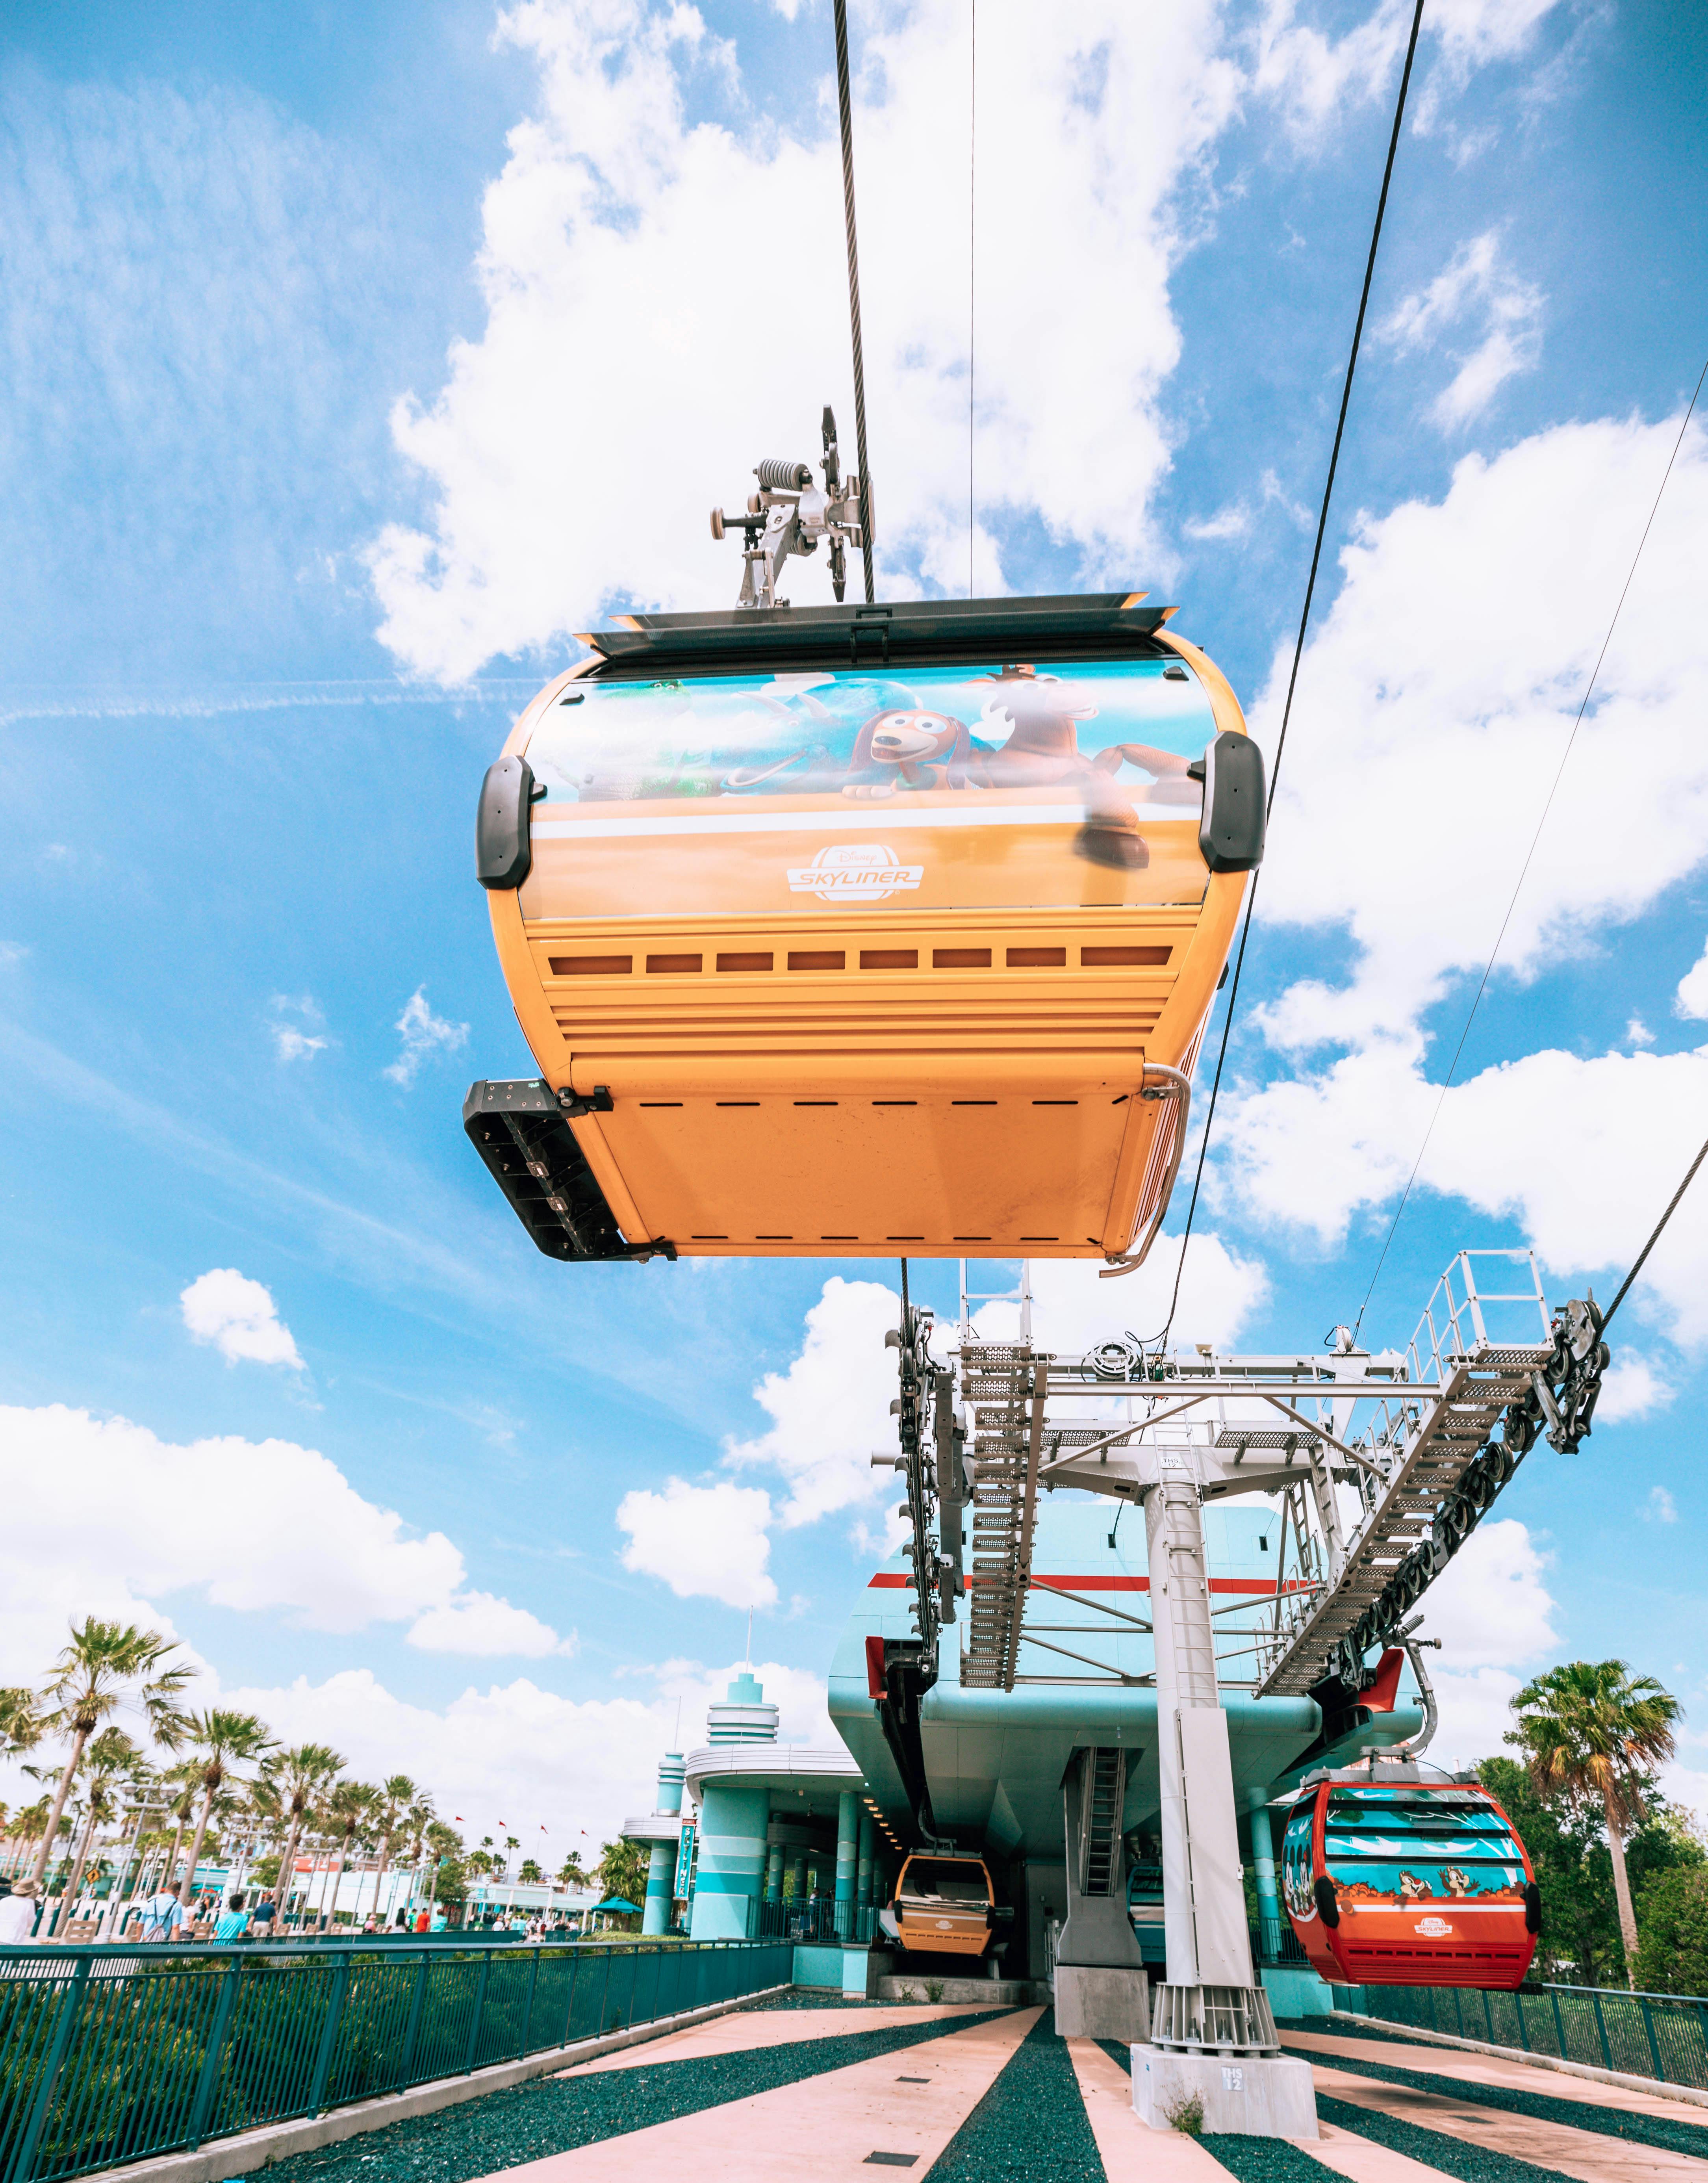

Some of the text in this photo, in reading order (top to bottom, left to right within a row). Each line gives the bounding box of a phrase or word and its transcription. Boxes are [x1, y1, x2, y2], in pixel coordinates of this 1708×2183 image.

[835, 850, 877, 864] Disney
[799, 871, 912, 887] SKYLINER
[679, 1828, 691, 1895] SKYLINER
[1221, 2067, 1243, 2078] THS
[1226, 2079, 1241, 2090] 12
